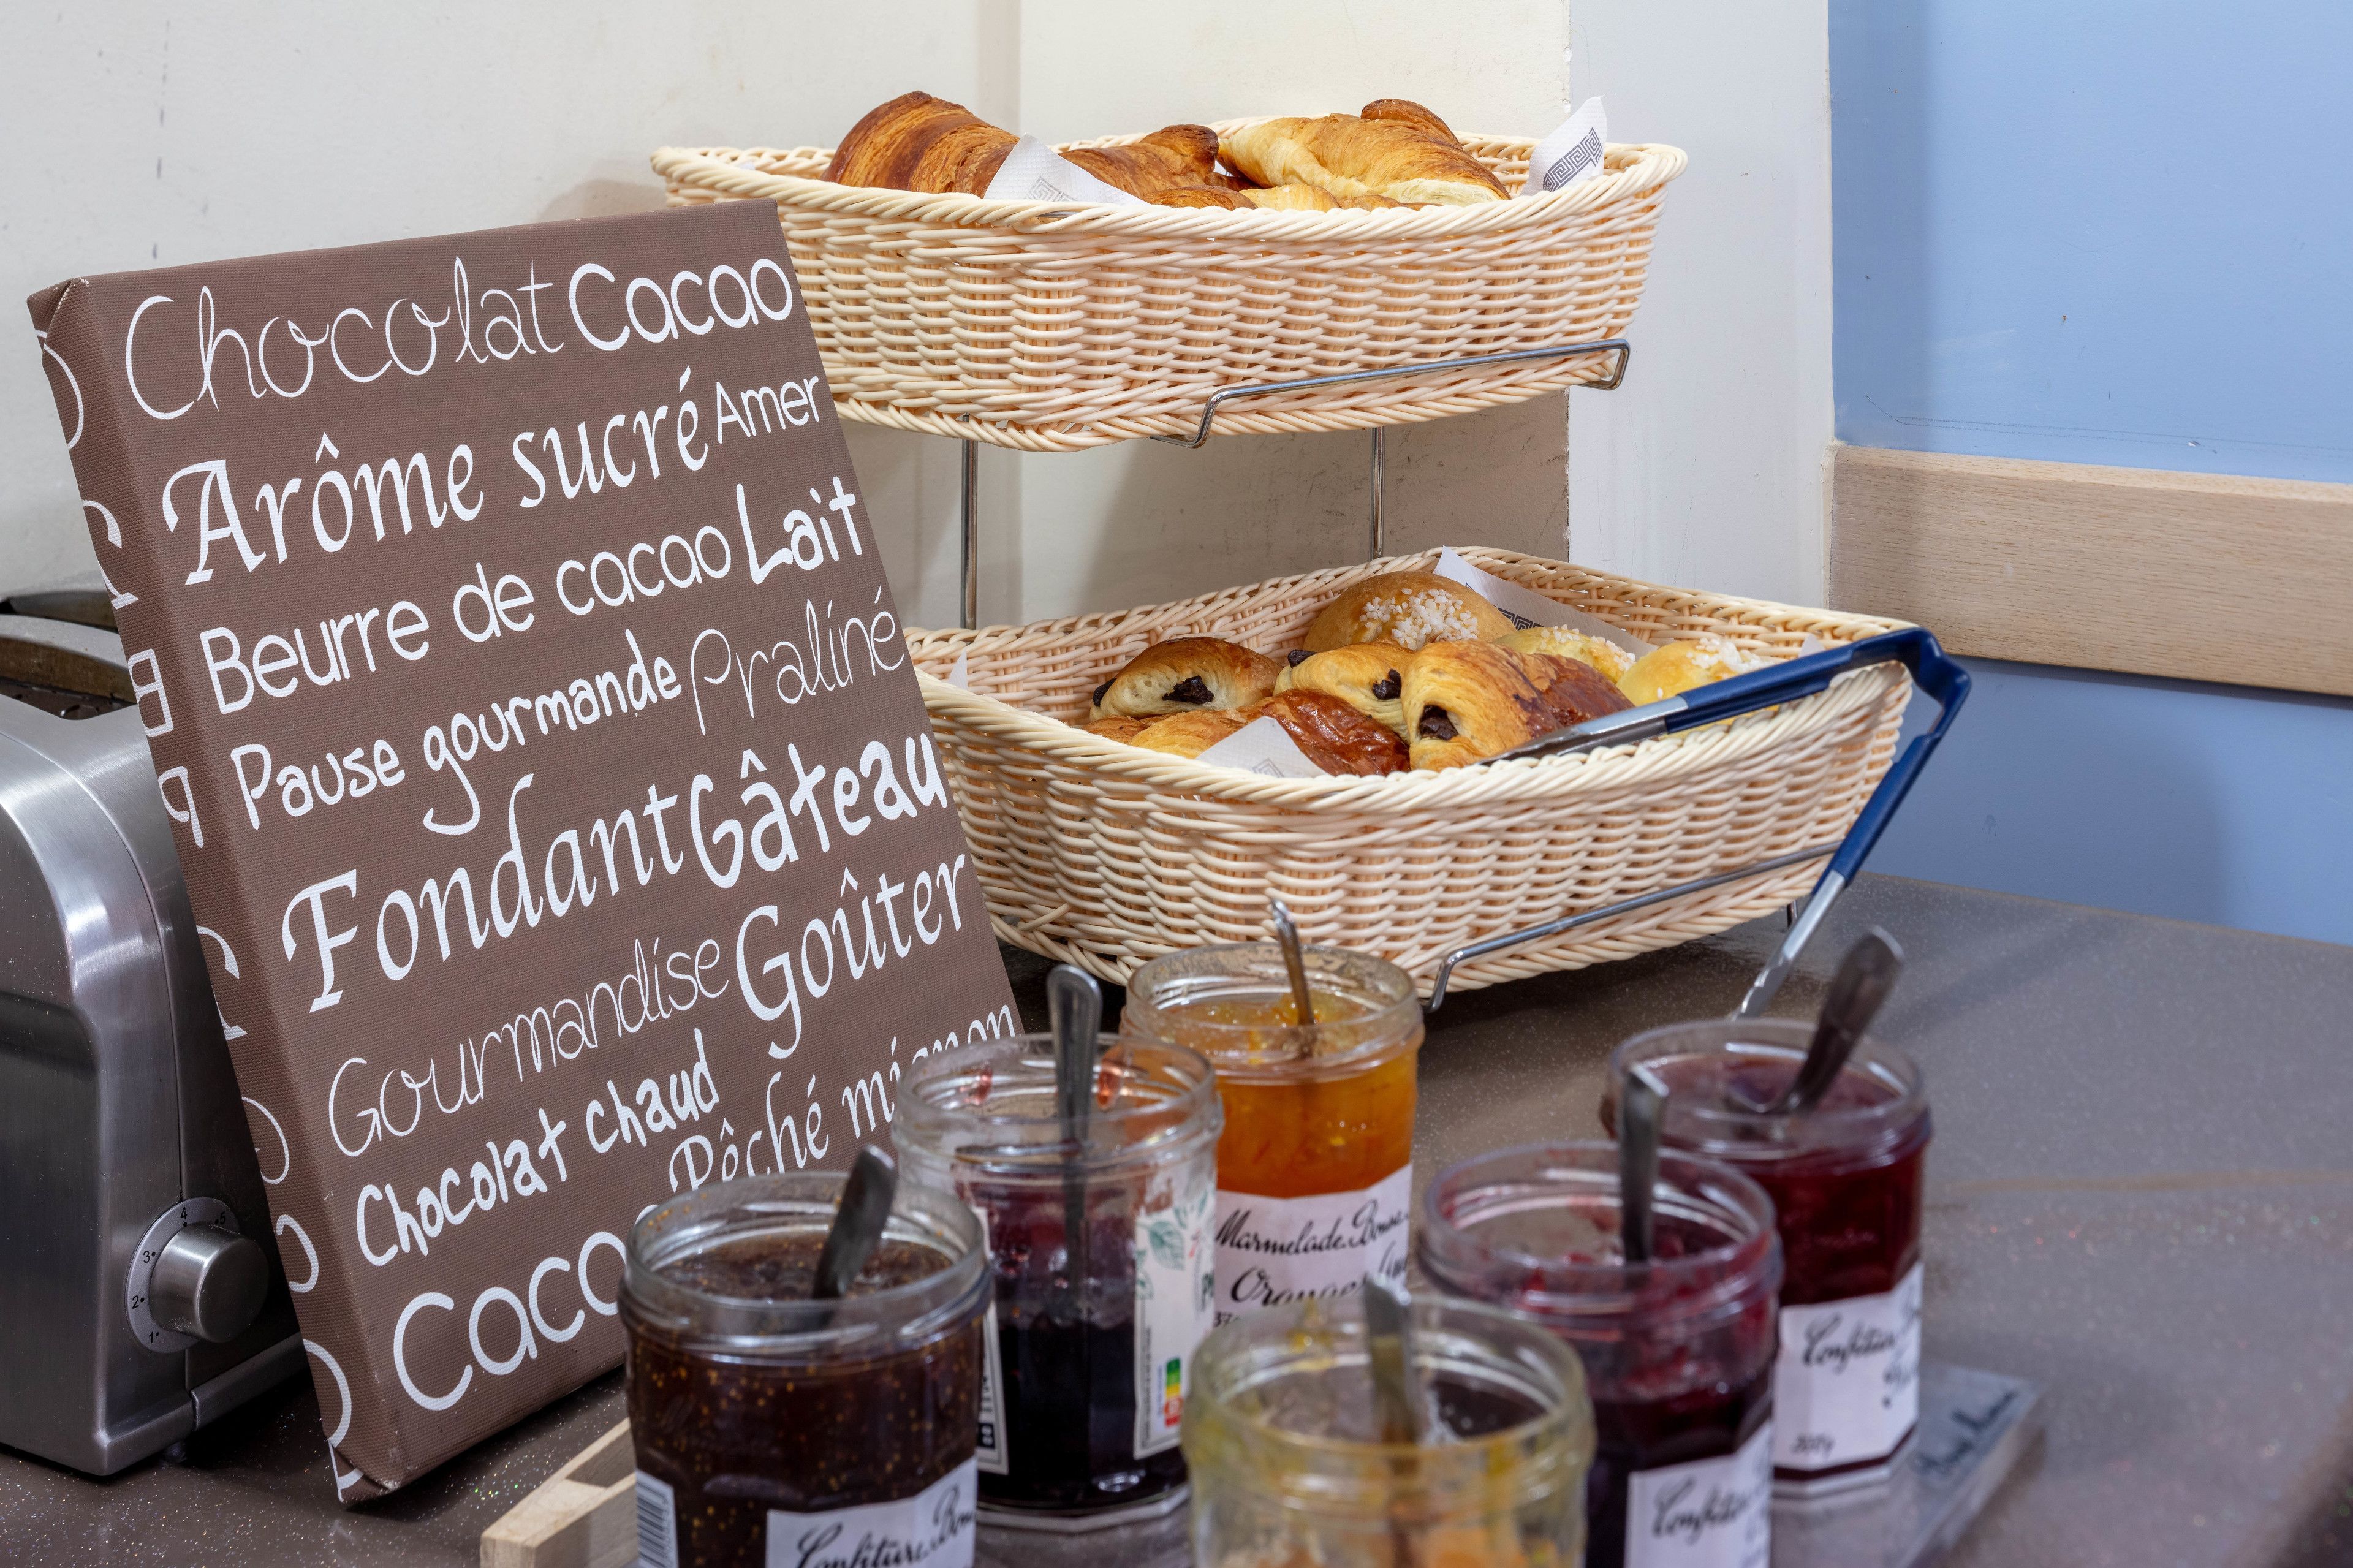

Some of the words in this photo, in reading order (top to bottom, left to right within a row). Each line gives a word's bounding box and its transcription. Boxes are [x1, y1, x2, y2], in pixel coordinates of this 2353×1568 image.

[125, 256, 564, 420] Chocolat
[568, 258, 793, 352] Cacao
[162, 431, 485, 586] Arôme
[512, 365, 708, 509] sucré
[716, 375, 820, 444] Amer
[199, 600, 430, 715] Beurre
[453, 562, 534, 643] de
[556, 525, 732, 616] cacao
[736, 475, 863, 586] Lait
[230, 739, 406, 831] Pause
[422, 629, 681, 836] gourmande
[689, 585, 905, 736] Praliné
[281, 773, 684, 1013] Fondant
[689, 733, 948, 890] Gâteau
[328, 937, 729, 1157] Gourmandise
[736, 854, 966, 1059] Goûter
[180, 1206, 188, 1220] 4
[356, 1108, 567, 1267] Chocolat
[585, 1027, 719, 1154] chaud
[669, 1070, 829, 1194] Pêché
[143, 1250, 151, 1264] 3
[219, 1211, 226, 1225] 5
[132, 1295, 139, 1309] 2
[148, 1331, 153, 1344] 1
